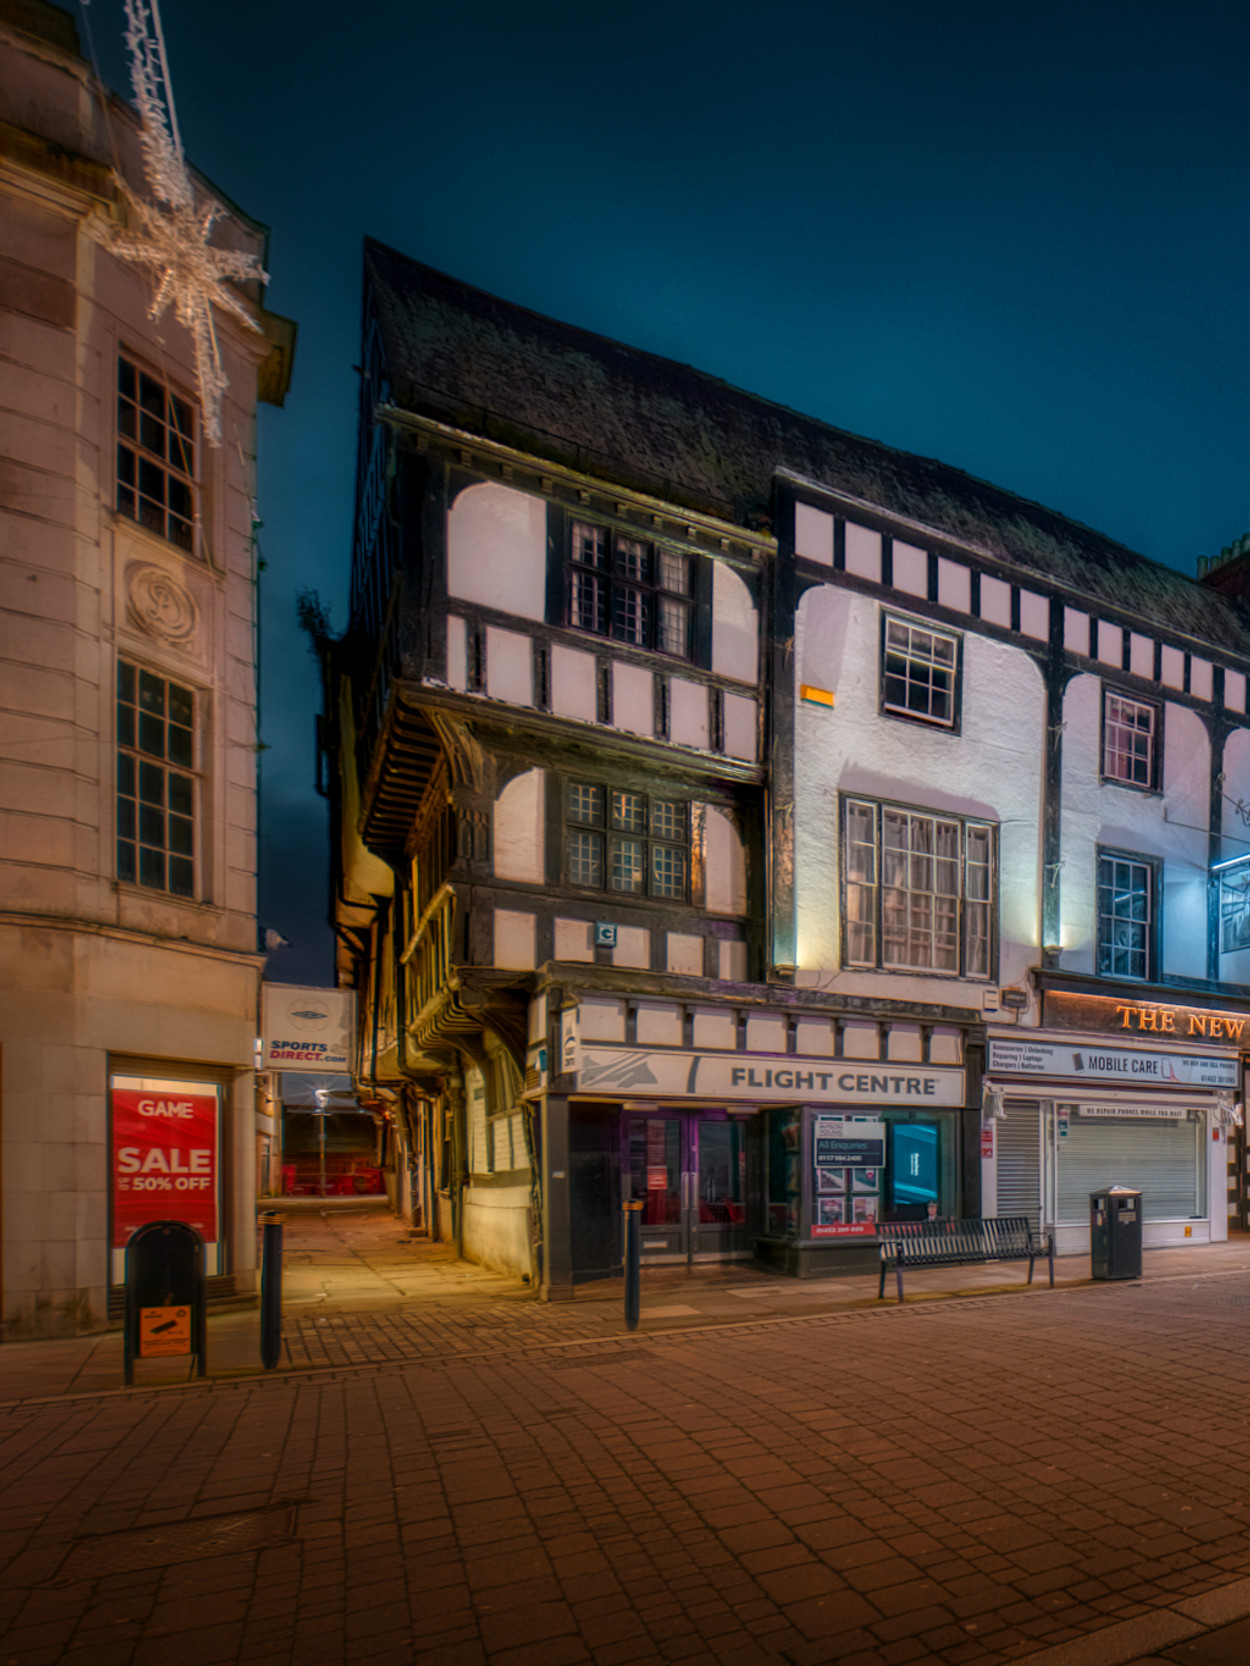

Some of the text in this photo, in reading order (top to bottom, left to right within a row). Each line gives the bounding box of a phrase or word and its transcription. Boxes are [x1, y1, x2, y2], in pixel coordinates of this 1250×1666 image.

[1116, 1005, 1176, 1032] THE
[1187, 1014, 1246, 1039] NEW
[271, 1040, 327, 1052] SPORTS
[993, 1060, 1016, 1069] Chargers
[1088, 1055, 1158, 1074] MOBILE CARE
[730, 1067, 936, 1095] FLIGHT CENTRE
[138, 1100, 194, 1119] GAME
[1096, 1107, 1116, 1115] REPAIR
[818, 1140, 868, 1151] All Enquiries
[117, 1147, 211, 1174] SALE
[132, 1177, 211, 1191] 50% OFF
